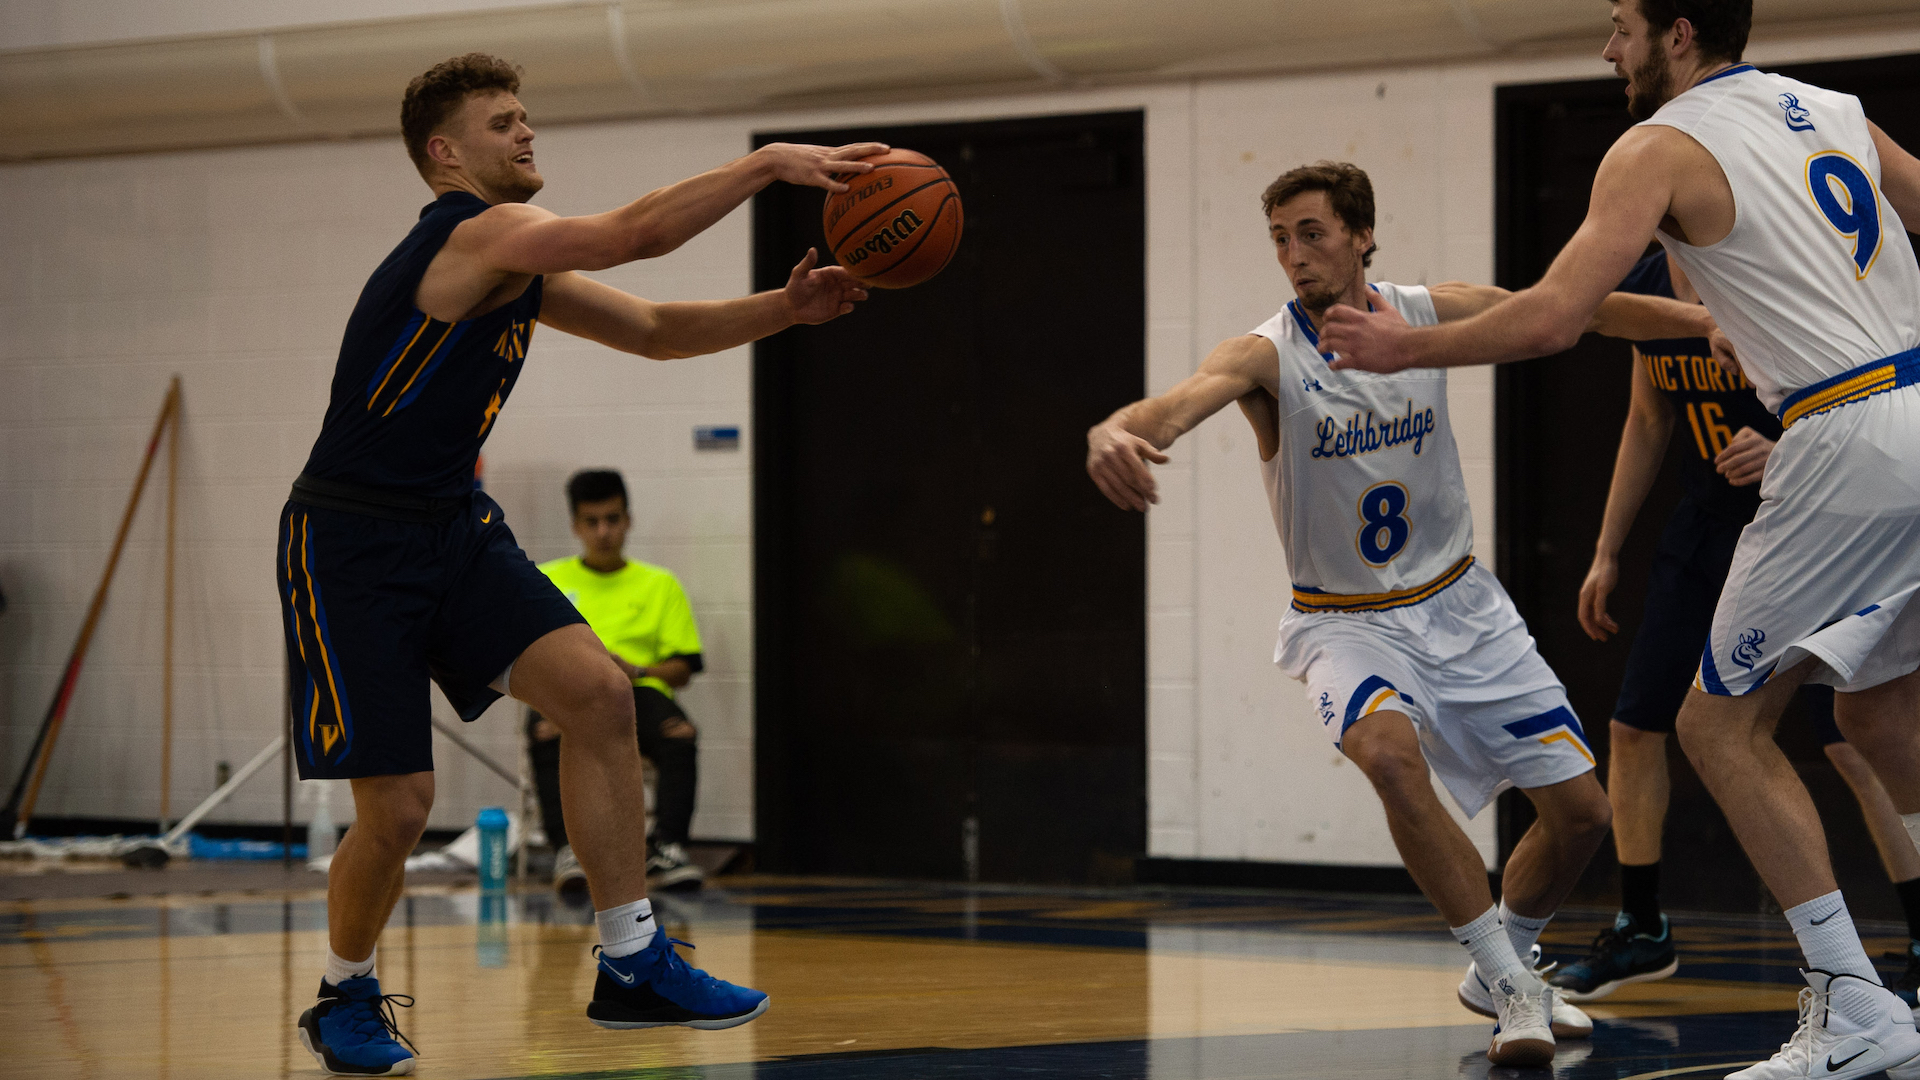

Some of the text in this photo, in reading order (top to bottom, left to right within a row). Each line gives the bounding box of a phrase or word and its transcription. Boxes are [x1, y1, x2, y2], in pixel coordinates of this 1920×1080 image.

[844, 209, 924, 267] Wilson
[1805, 150, 1883, 281] 9
[1311, 398, 1436, 459] Lethbridge
[1686, 402, 1733, 460] 16
[1356, 480, 1413, 569] 8
